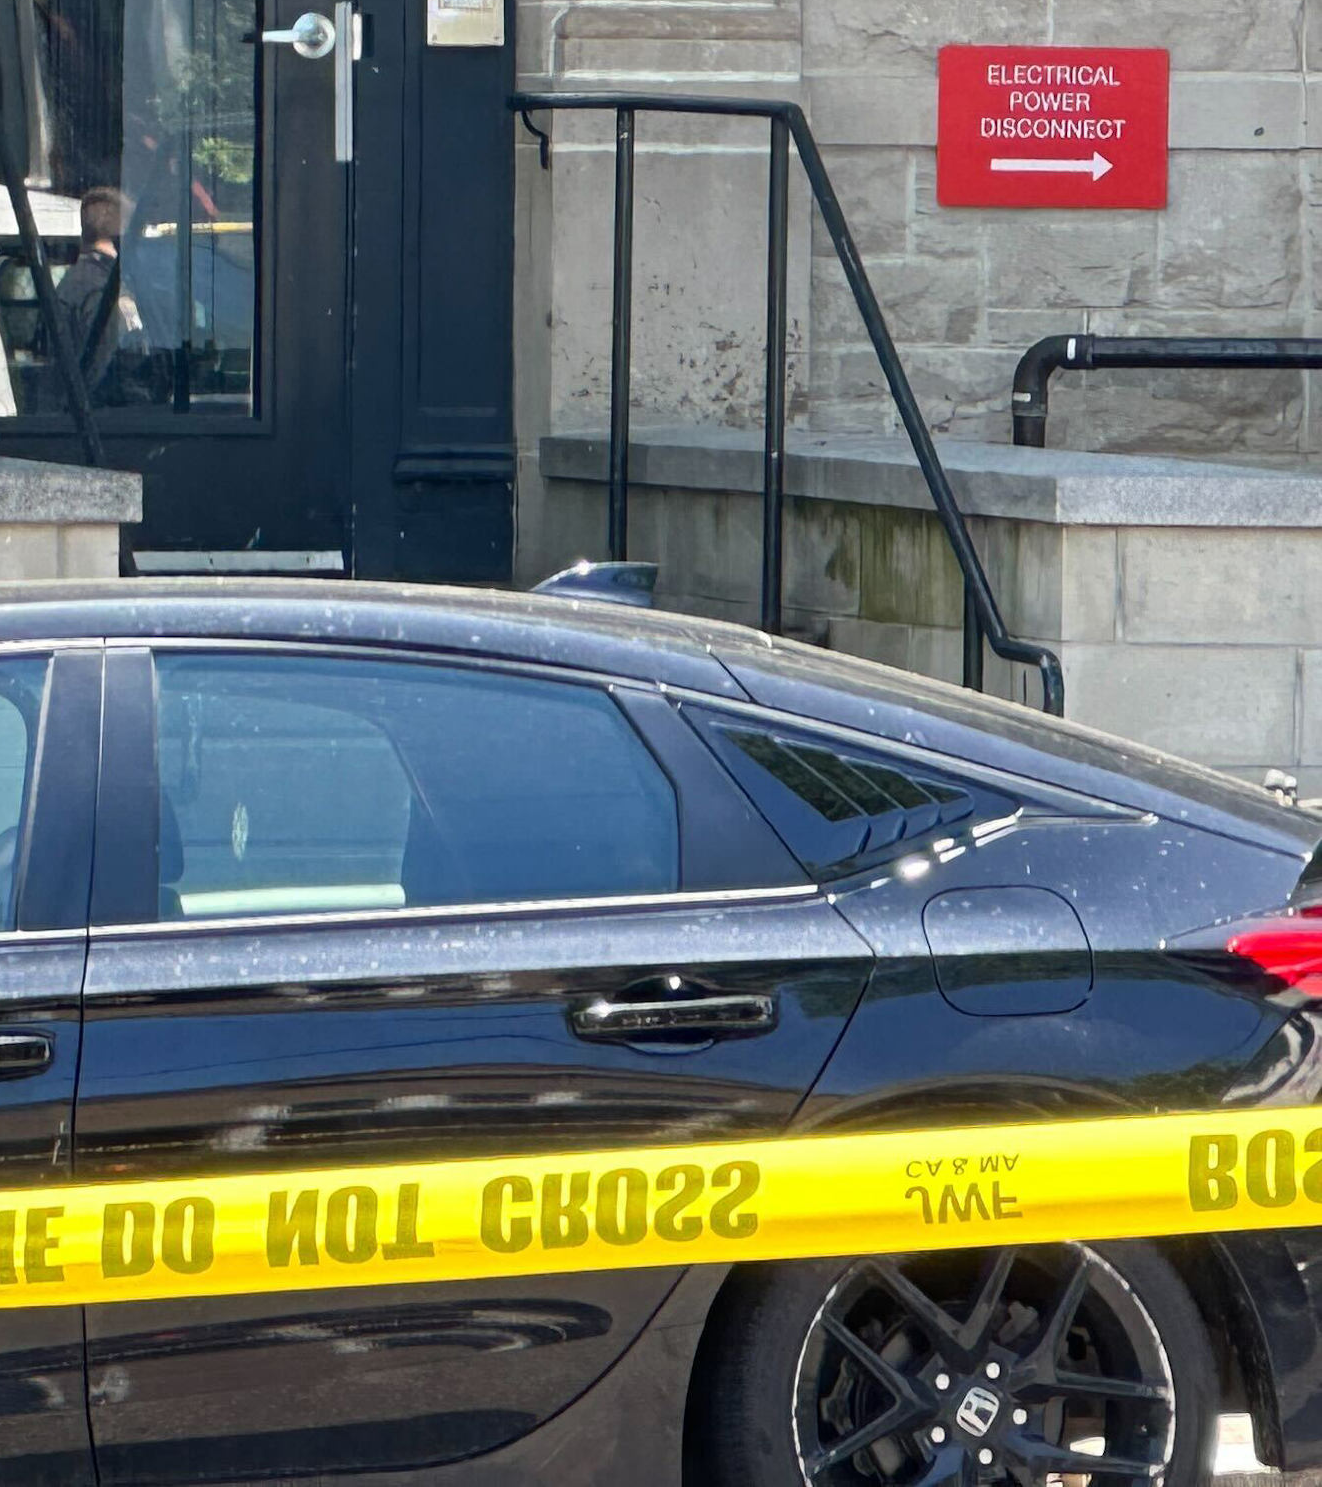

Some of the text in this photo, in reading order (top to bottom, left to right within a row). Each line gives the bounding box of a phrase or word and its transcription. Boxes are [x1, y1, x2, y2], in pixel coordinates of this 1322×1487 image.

[986, 64, 1122, 87] ELECTRICAL
[1009, 90, 1091, 112] POWER
[979, 116, 1127, 140] DISCONNECT
